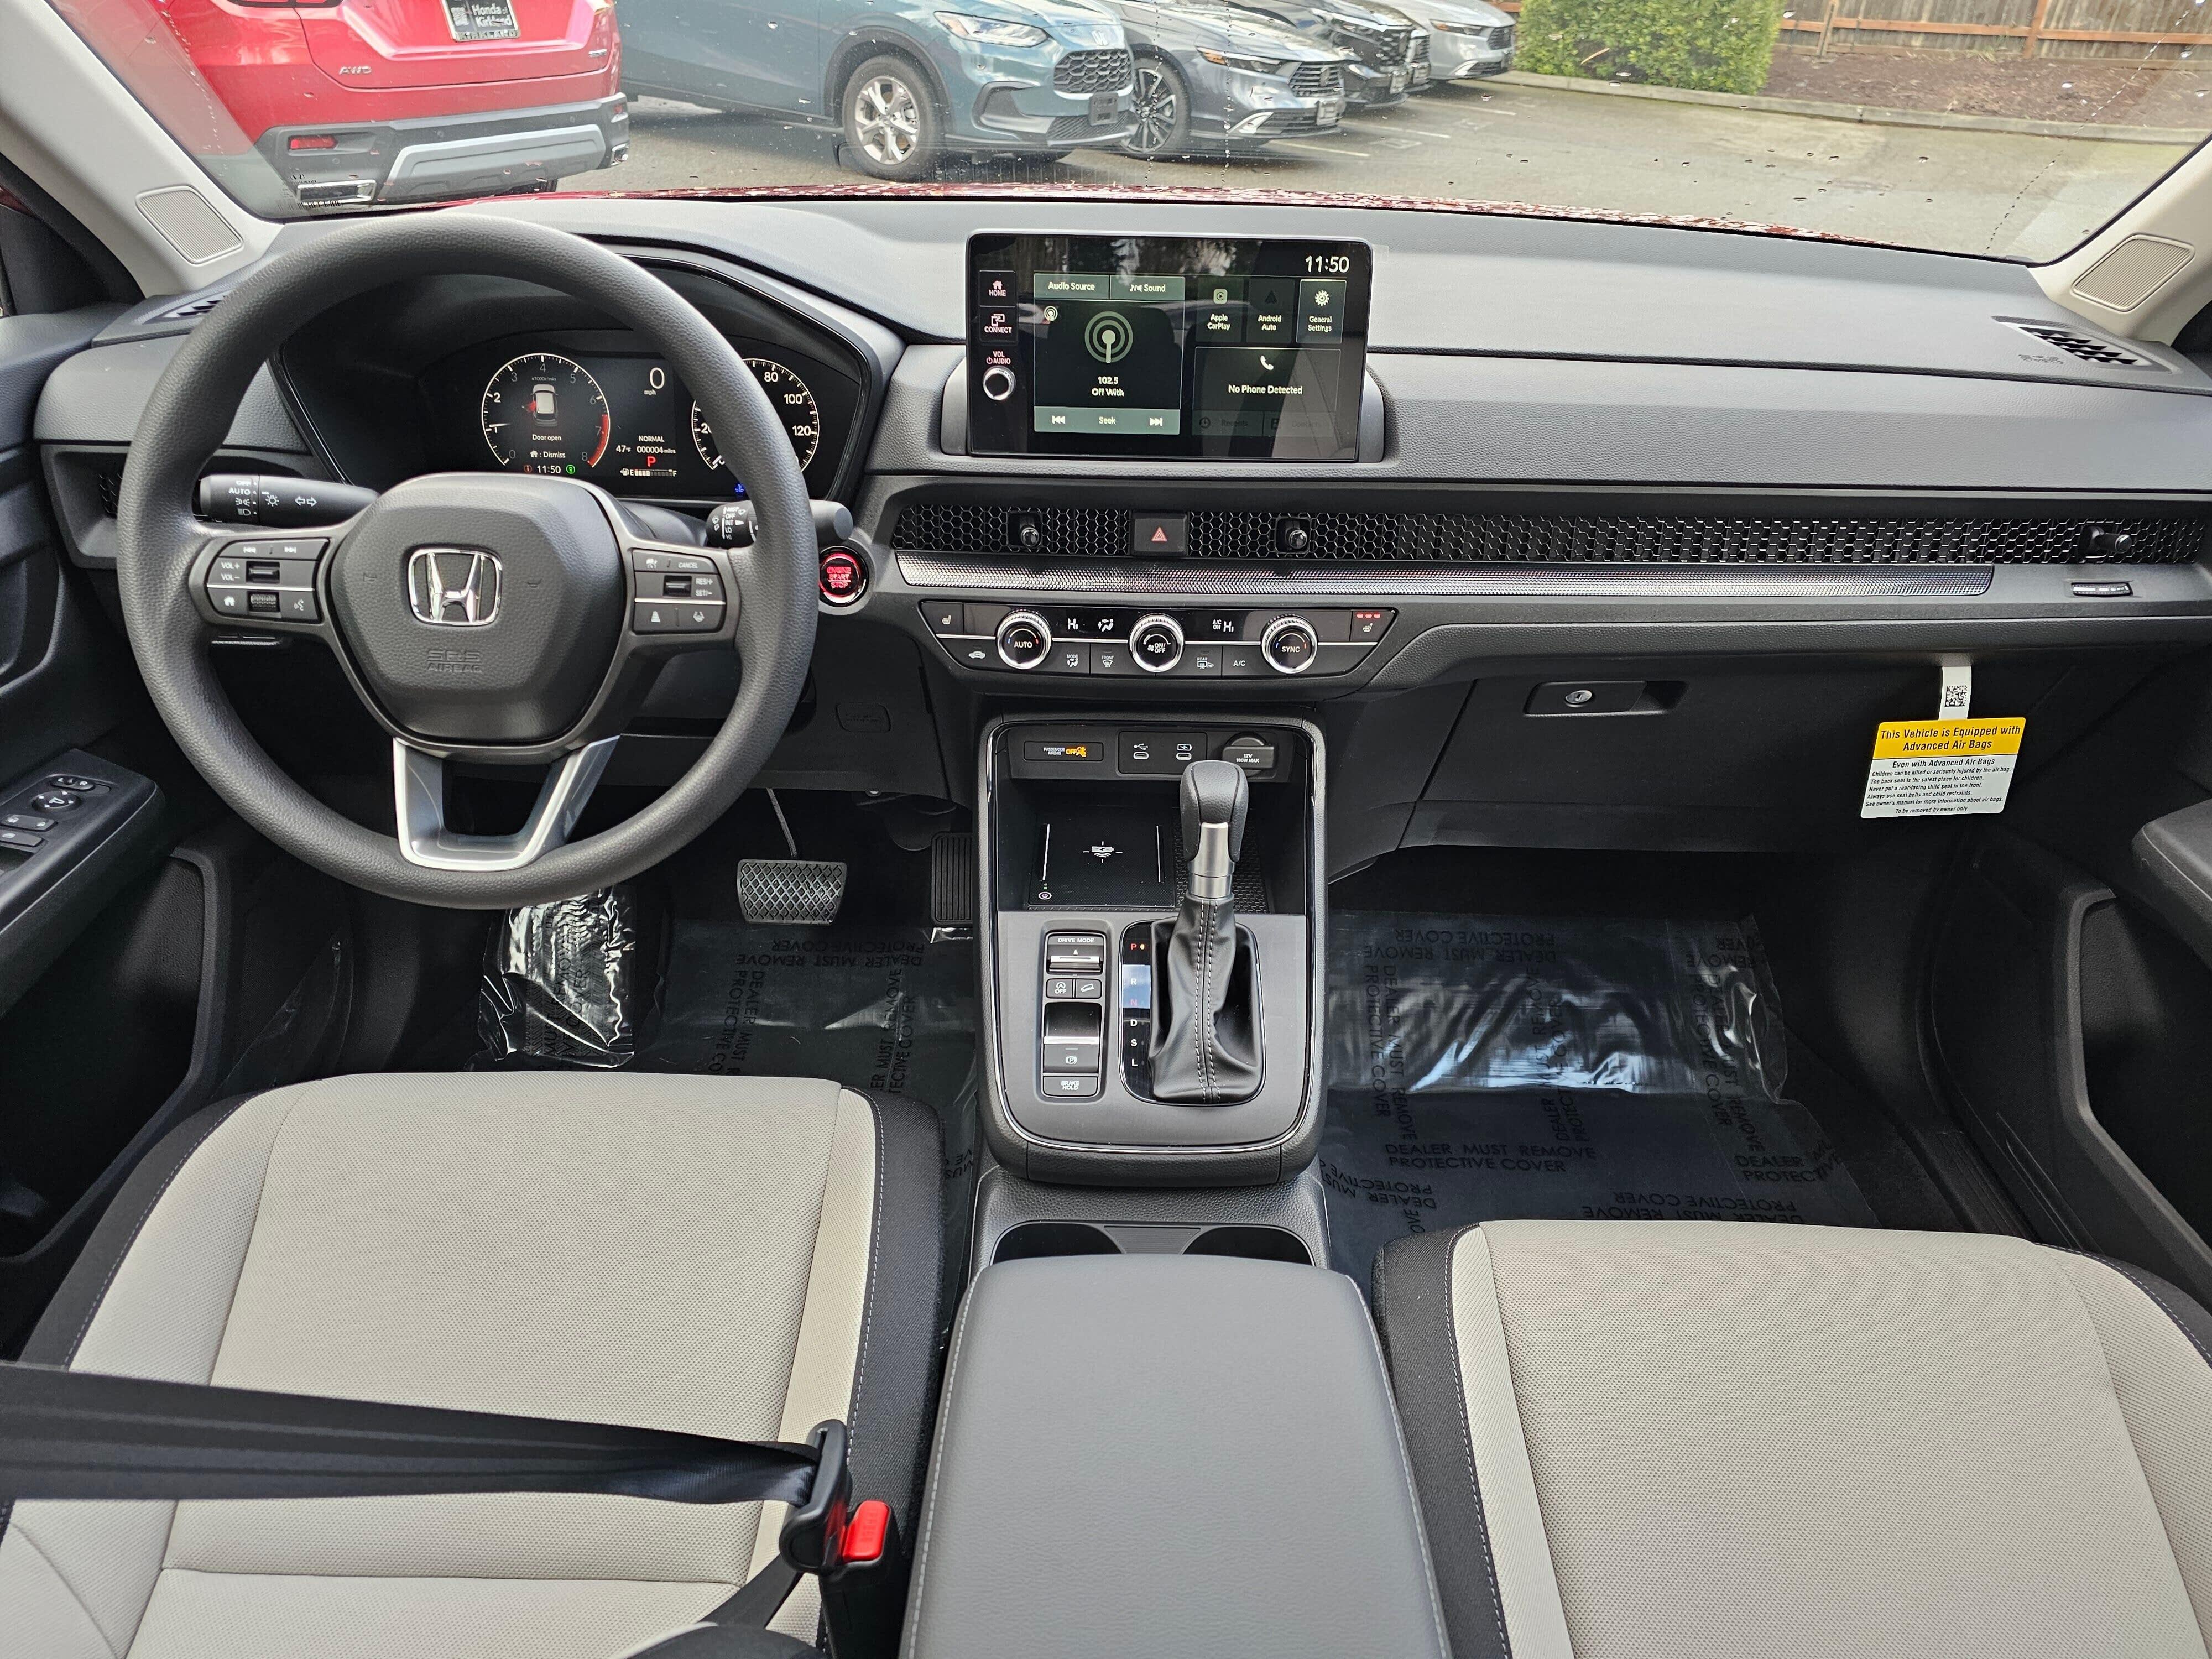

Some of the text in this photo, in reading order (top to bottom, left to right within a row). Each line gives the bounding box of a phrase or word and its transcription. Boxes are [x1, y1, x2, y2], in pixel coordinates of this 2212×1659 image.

[472, 3, 502, 15] Honda
[338, 65, 372, 75] AWD
[1305, 255, 1350, 273] 11:50
[1047, 281, 1095, 291] Audio Source
[1144, 284, 1166, 293] Sound
[1210, 314, 1228, 325] Apple
[1257, 315, 1282, 323] Android
[1308, 315, 1332, 324] General
[1207, 322, 1230, 331] CarPlay
[1307, 324, 1332, 333] Settings
[539, 363, 546, 372] 4
[511, 372, 518, 382] 3
[570, 373, 576, 383] 5
[649, 367, 665, 389] 0
[764, 371, 779, 382] 80
[1098, 376, 1119, 384] 102.5
[1091, 388, 1124, 397] Off With
[1228, 384, 1303, 395] No Phone Detected
[493, 392, 502, 403] 2
[784, 393, 803, 404] 100
[1098, 416, 1116, 425] Seek
[792, 425, 811, 436] 120
[547, 434, 562, 443] open
[543, 450, 566, 458] Dismiss
[647, 456, 656, 467] P
[537, 465, 561, 474] 11:50
[228, 487, 251, 495] AUTO
[827, 566, 851, 575] ENGINE
[426, 649, 481, 661] SRS
[1881, 726, 2021, 739] This Vehicle is Equipped with
[1902, 739, 1992, 751] Advanced Air Bags
[1928, 759, 1963, 767] Advanced
[734, 953, 922, 967] DEALER MUST REMOVE
[1130, 1039, 1138, 1047] S
[1131, 1058, 1138, 1067] L
[1385, 1144, 1598, 1160] DEALER MUST REMOVE
[1388, 1157, 1567, 1173] PROTECTIVE COVER
